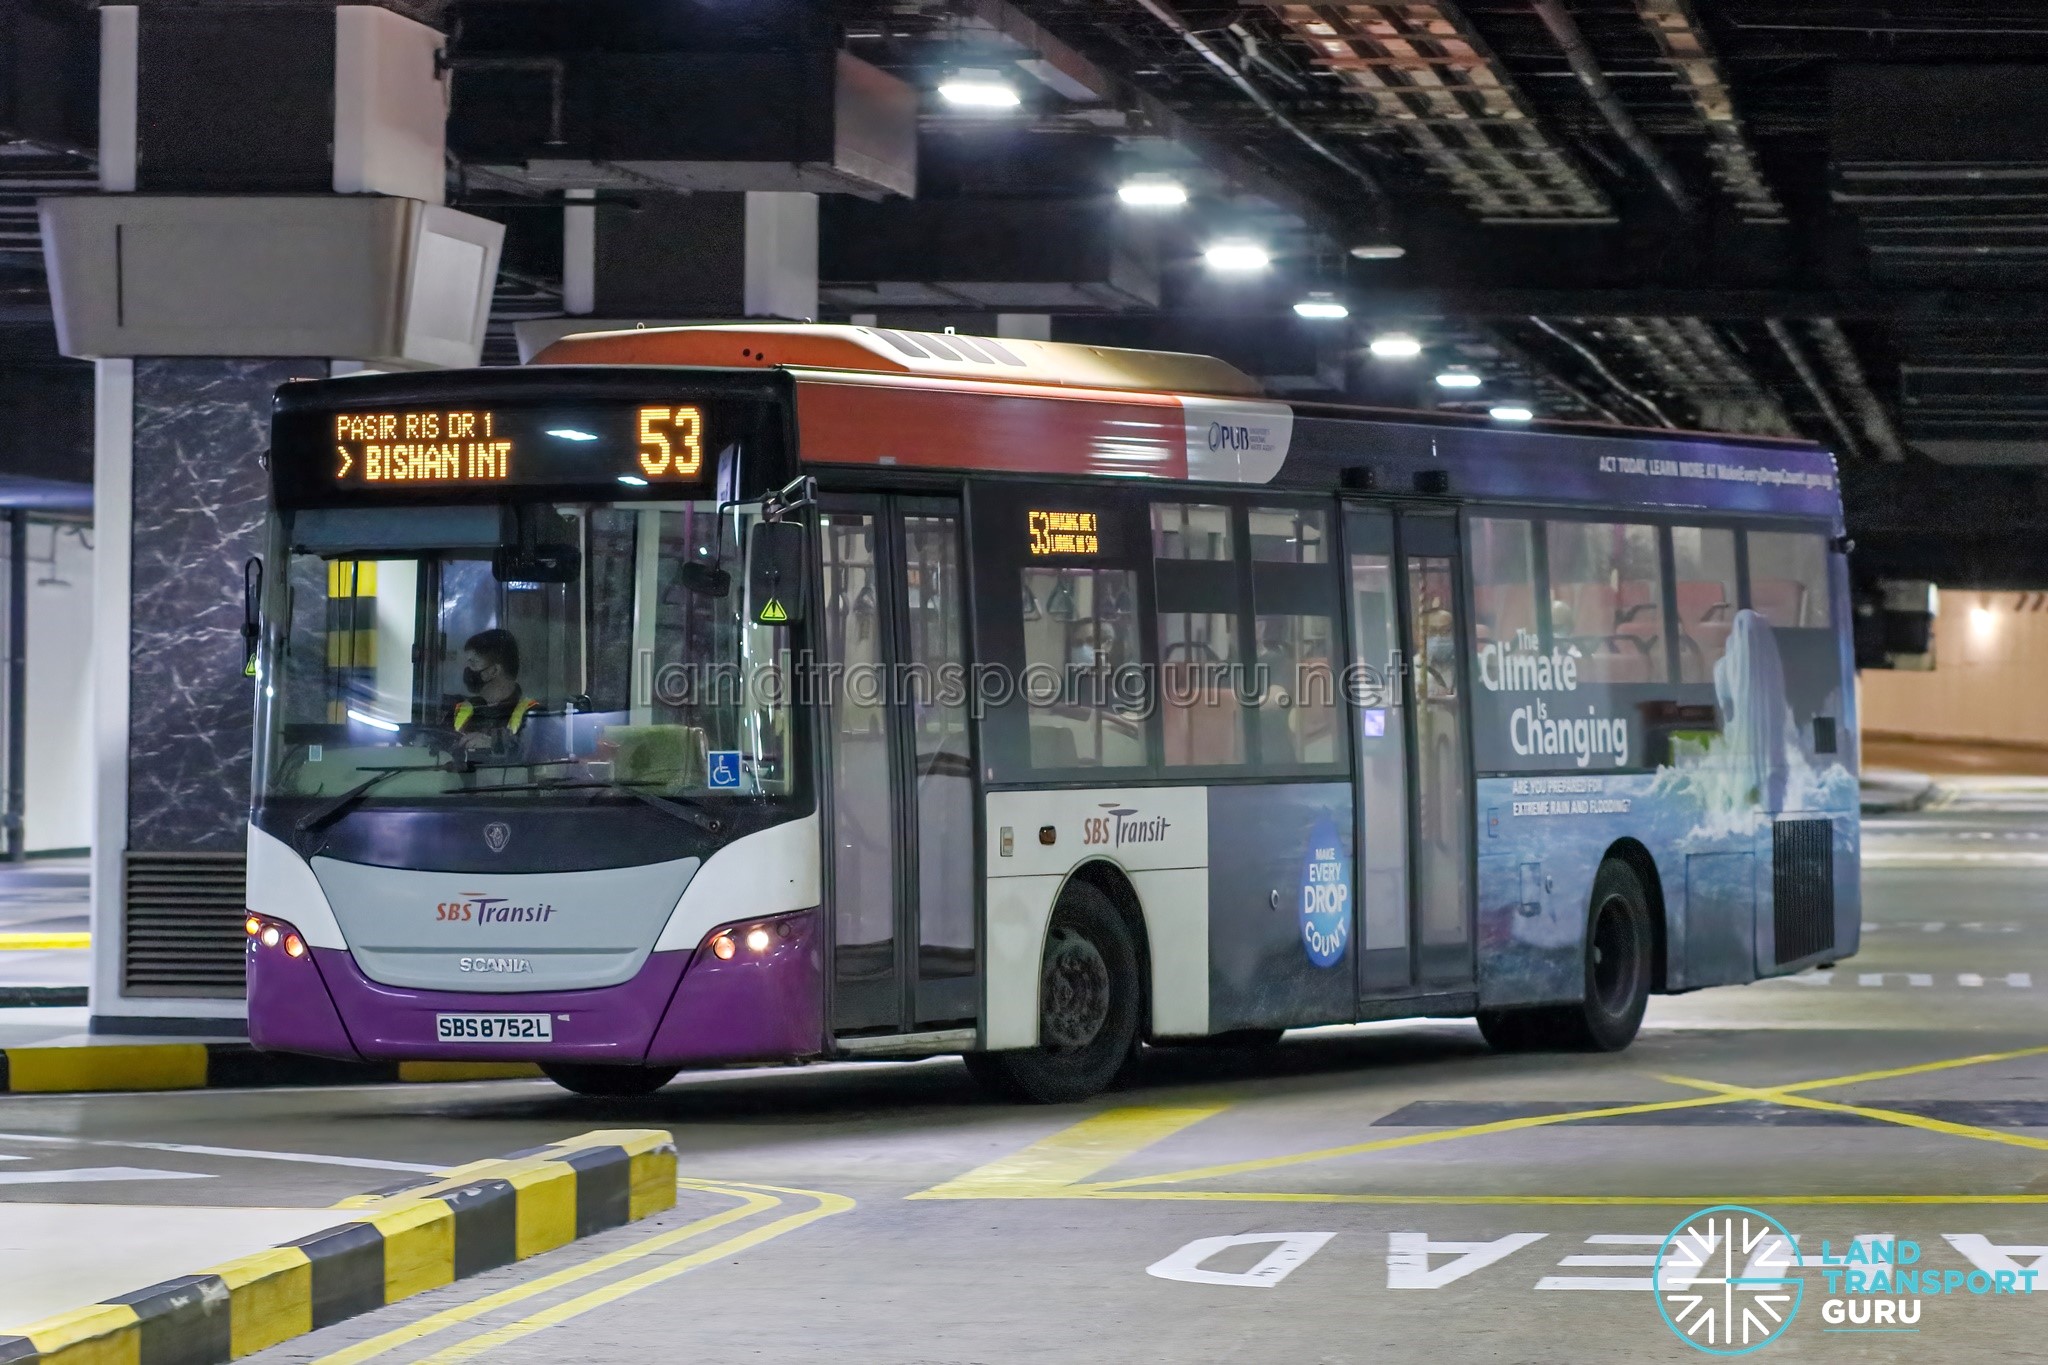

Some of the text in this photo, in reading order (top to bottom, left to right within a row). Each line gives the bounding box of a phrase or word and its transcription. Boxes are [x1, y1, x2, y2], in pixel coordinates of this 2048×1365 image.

[337, 412, 491, 440] PASIR RIS DR 1
[1221, 426, 1249, 450] PUB
[640, 406, 700, 476] 53
[366, 443, 511, 480] BISHAN INT
[1028, 512, 1050, 554] 53
[1517, 628, 1539, 650] The
[1482, 641, 1577, 691] Climate
[1537, 697, 1547, 719] Is
[1510, 705, 1628, 768] Changing
[1513, 779, 1530, 795] ARE
[1531, 779, 1546, 794] YOU
[1513, 801, 1549, 816] EXTREME
[1550, 800, 1570, 815] RAIN
[1570, 800, 1588, 814] AND
[1083, 809, 1171, 849] SBS Transit
[1315, 847, 1336, 860] MAKE
[1309, 863, 1341, 882] EVERY
[436, 898, 558, 926] SBS Transit
[1304, 884, 1347, 914] DROP
[1305, 918, 1347, 957] COUNT
[460, 957, 533, 973] SCANIA
[439, 1018, 549, 1037] SBS8752L
